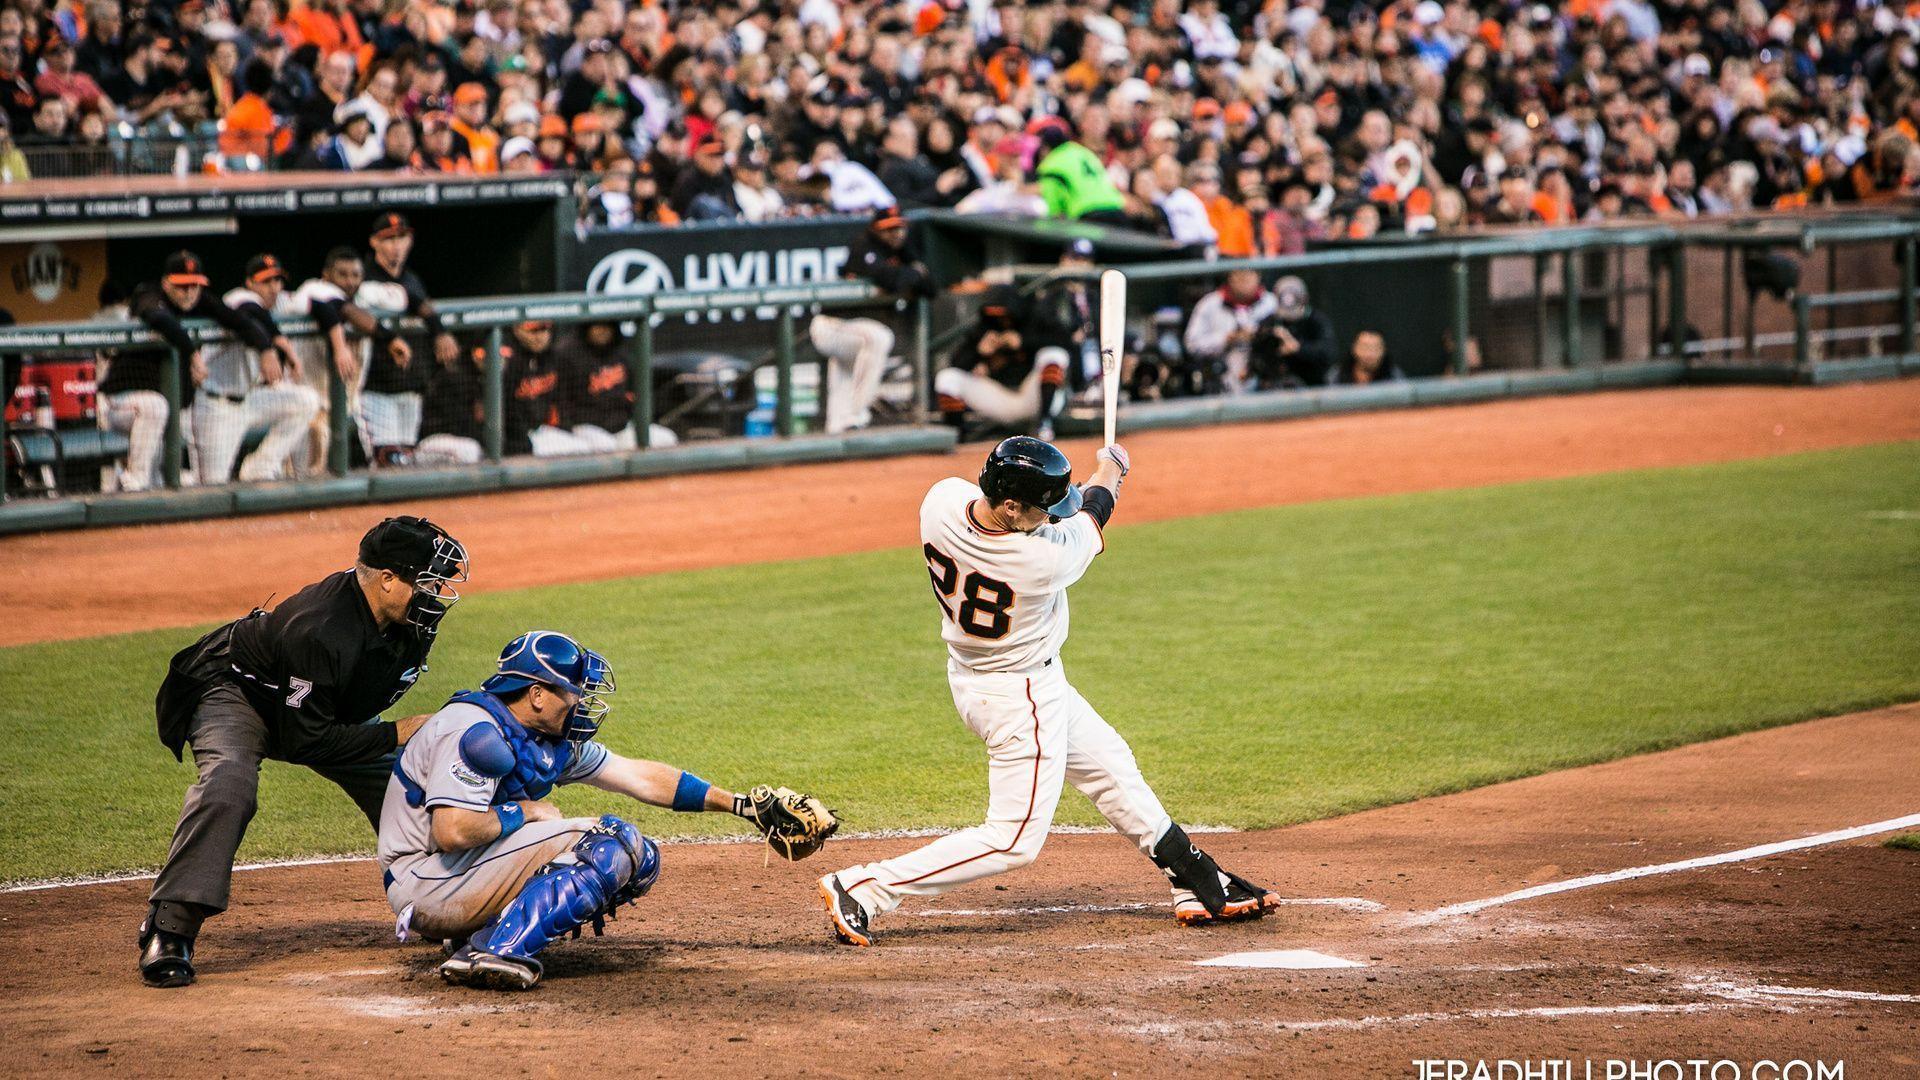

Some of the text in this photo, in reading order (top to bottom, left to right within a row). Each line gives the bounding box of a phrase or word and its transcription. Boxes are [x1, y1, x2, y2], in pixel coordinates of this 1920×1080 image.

[683, 247, 850, 310] HYUN
[923, 542, 1016, 640] 28
[286, 676, 313, 708] 7
